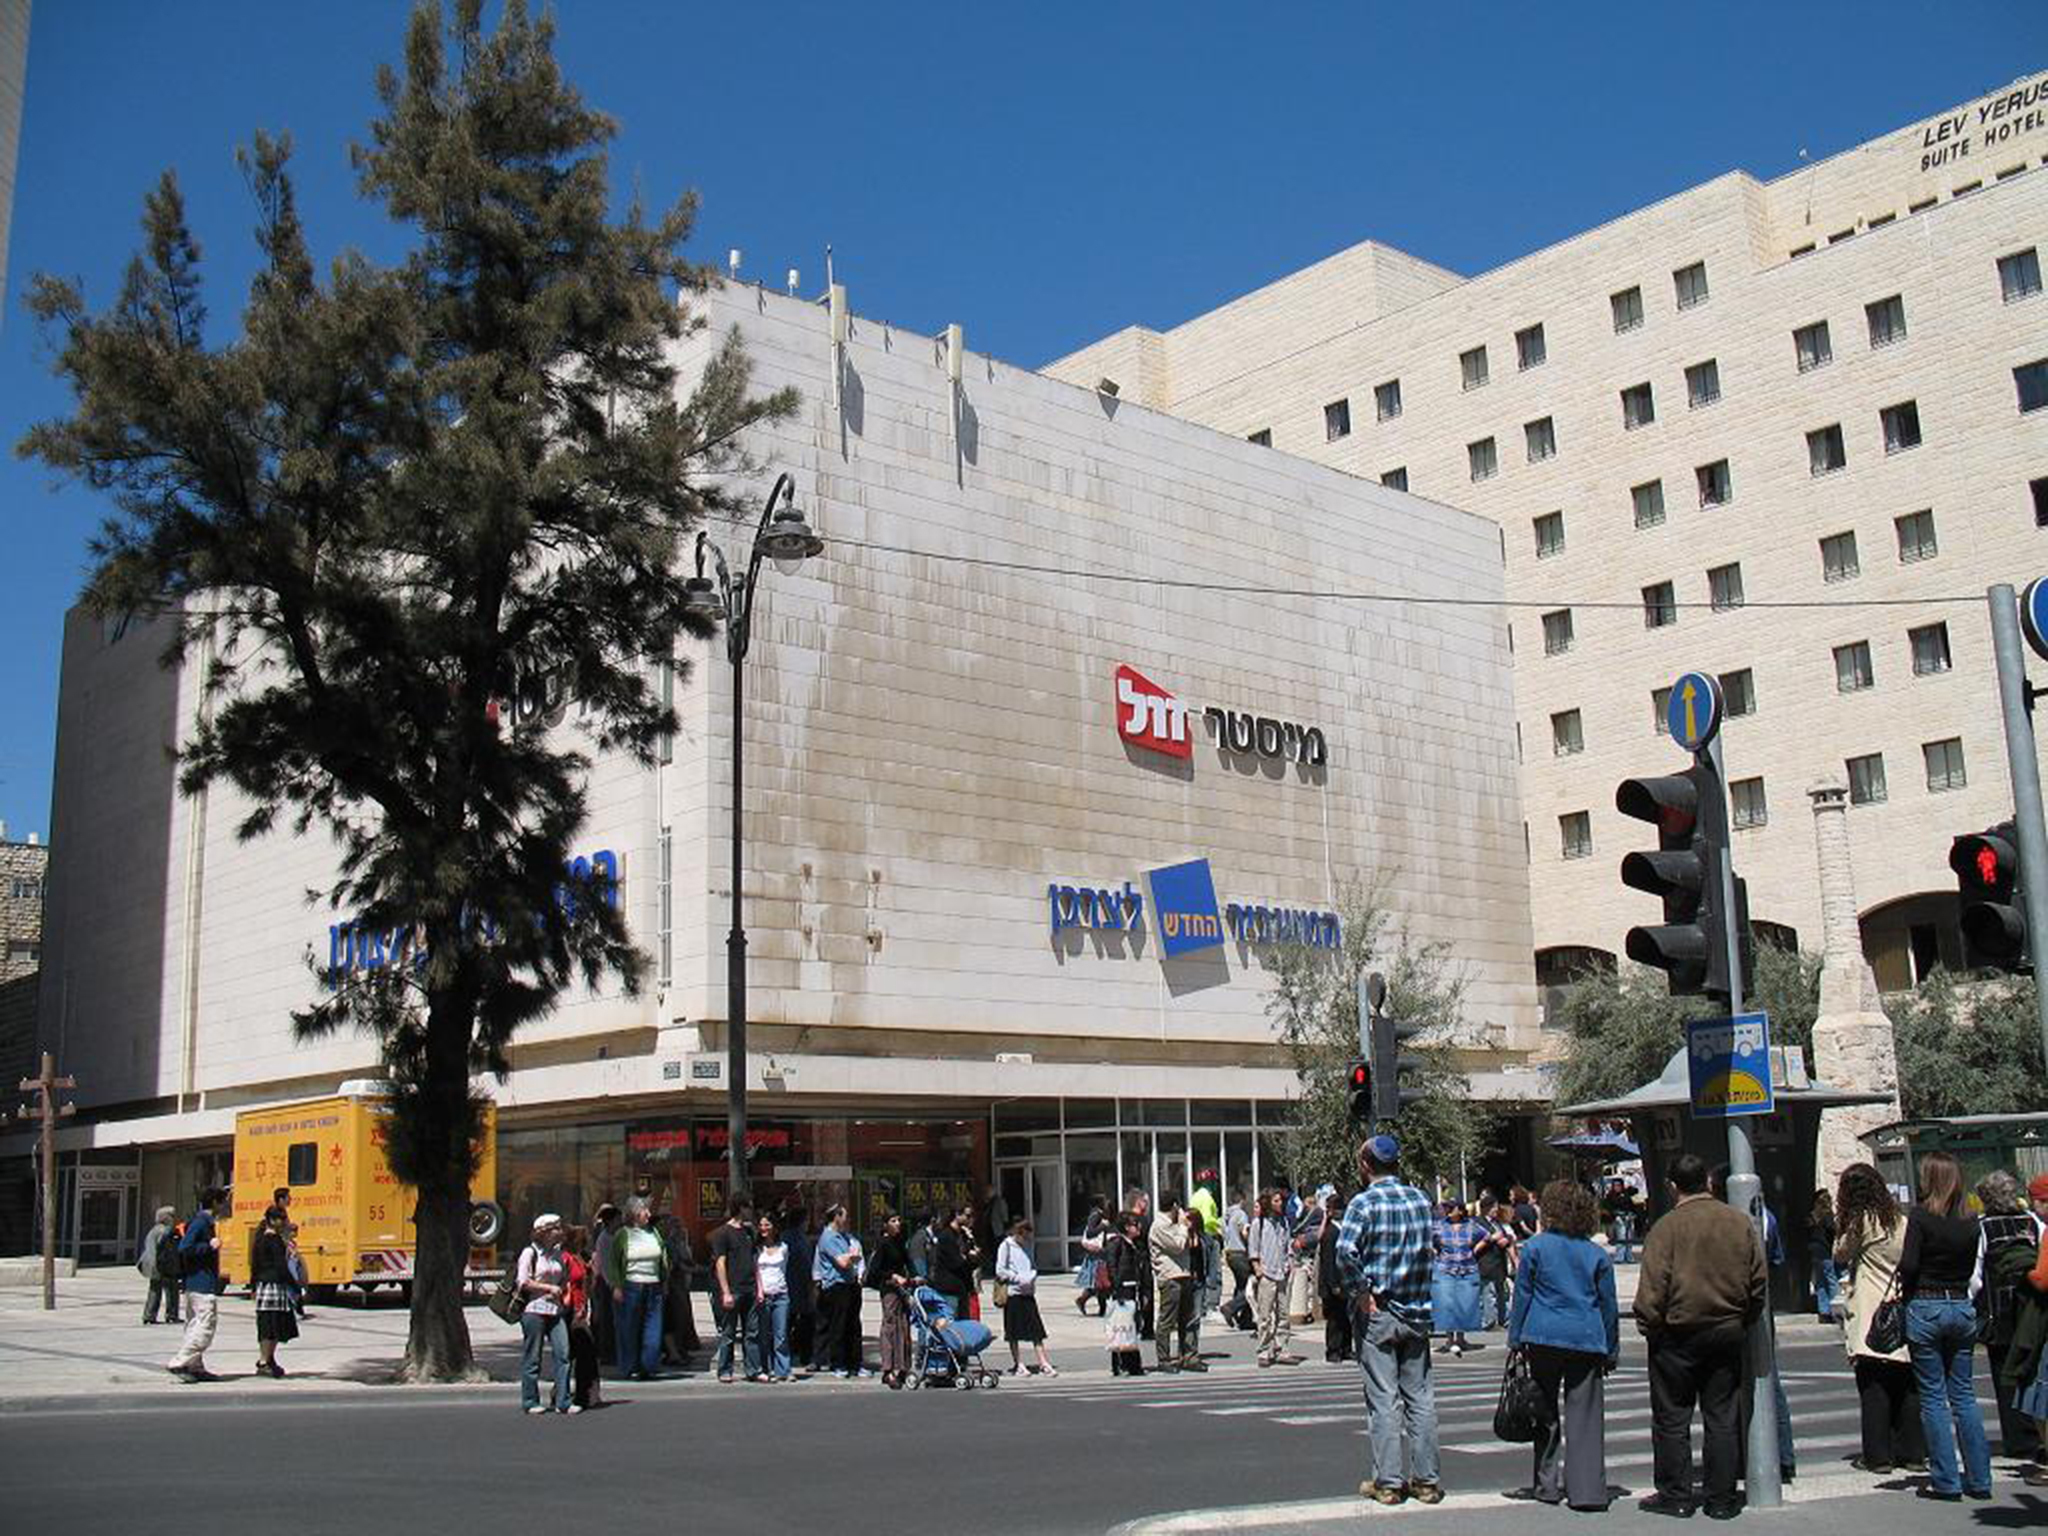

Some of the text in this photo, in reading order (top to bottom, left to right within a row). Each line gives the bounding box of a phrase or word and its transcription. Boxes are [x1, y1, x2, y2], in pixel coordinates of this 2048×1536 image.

[1921, 109, 2045, 172] SUITE HOTEL
[1923, 112, 1968, 148] LEV
[1118, 679, 1327, 766] מיסטר זול
[1164, 912, 1217, 937] החדש
[369, 1205, 385, 1221] 55
